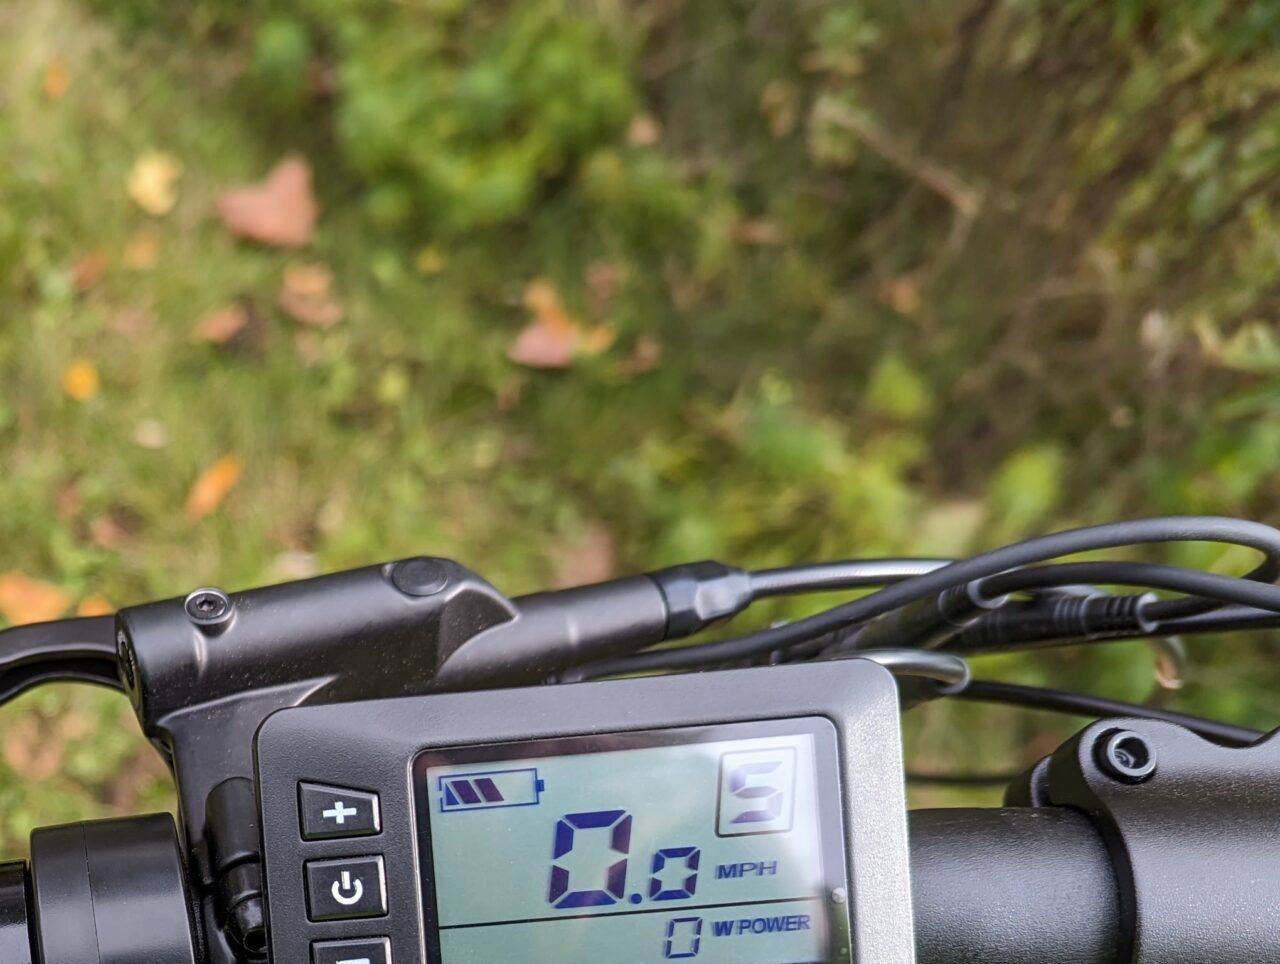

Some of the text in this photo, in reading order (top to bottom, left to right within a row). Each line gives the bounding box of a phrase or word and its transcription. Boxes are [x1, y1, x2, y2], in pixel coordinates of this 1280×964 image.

[548, 809, 777, 909] 0.0 MPH
[663, 914, 811, 959] 0 W POWER
